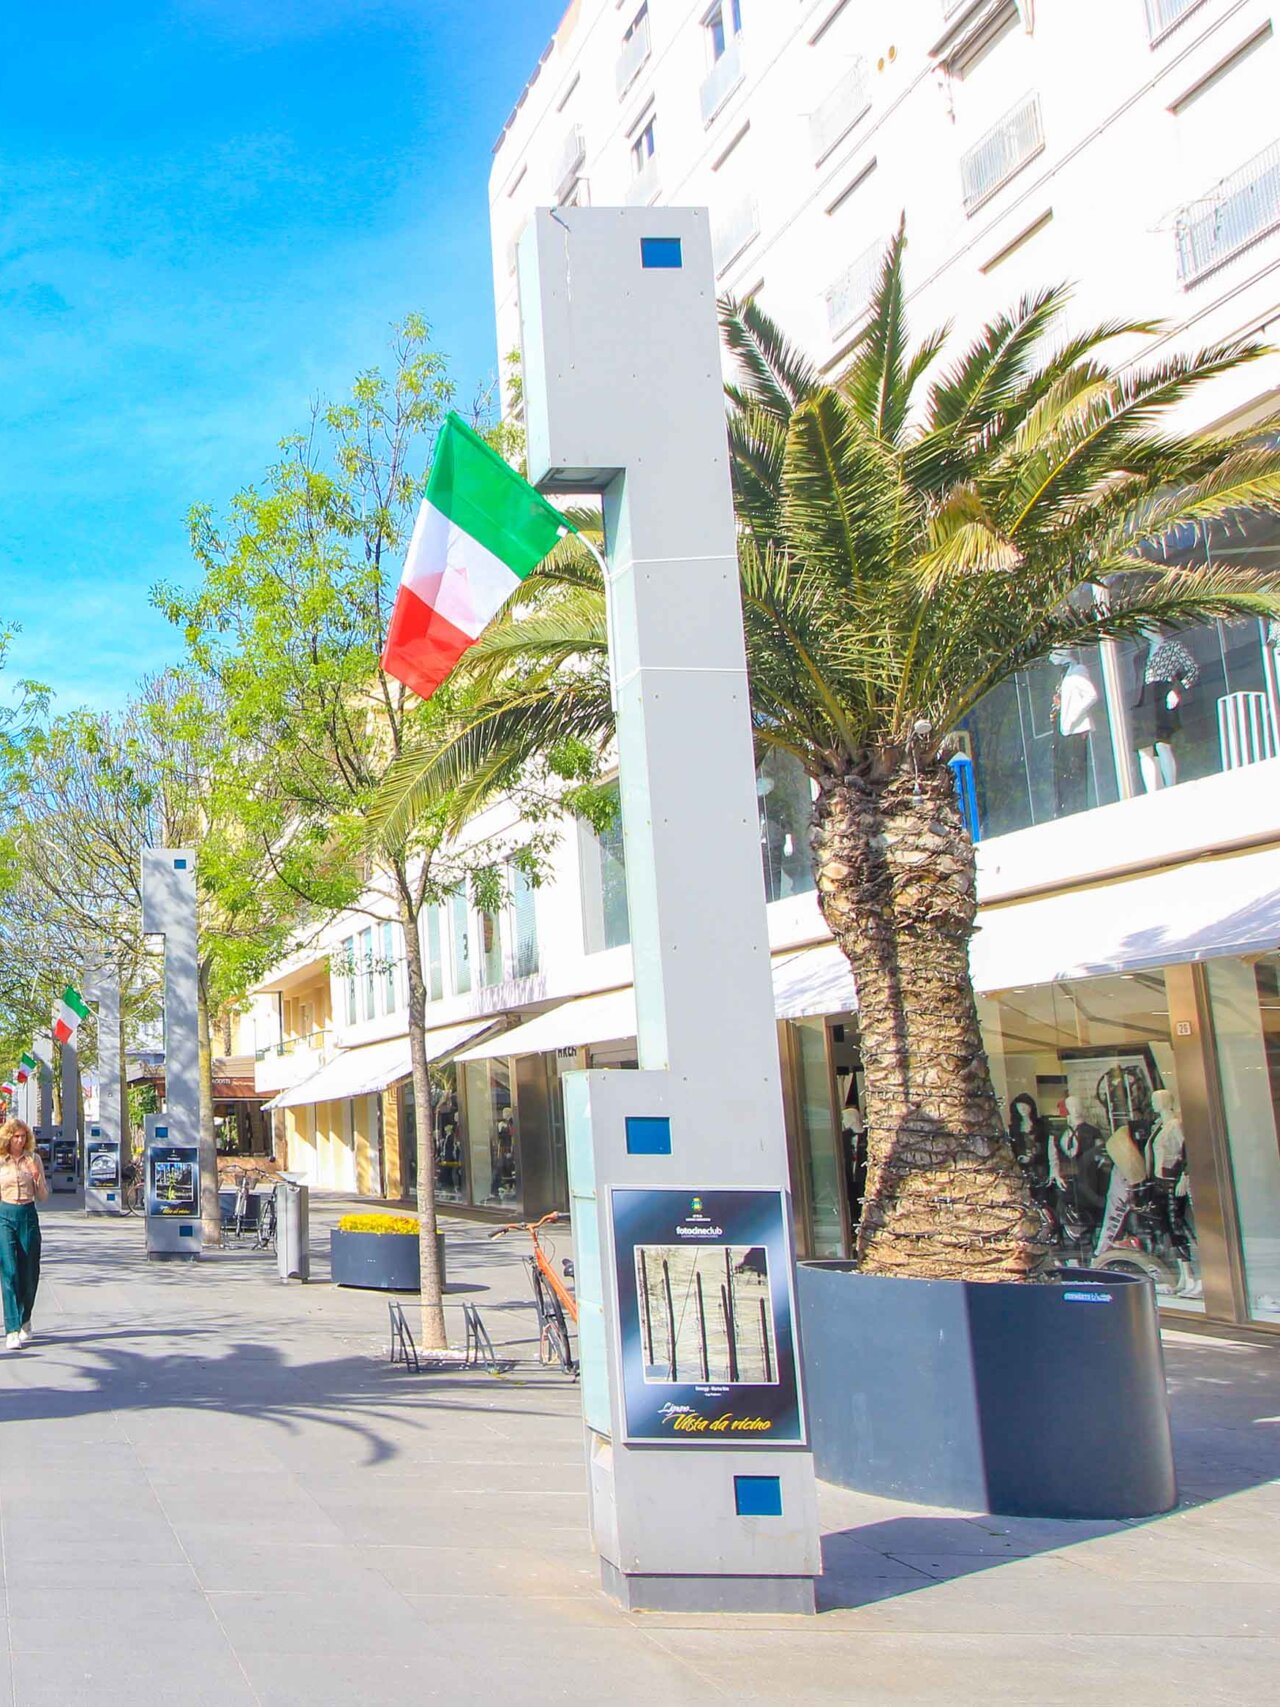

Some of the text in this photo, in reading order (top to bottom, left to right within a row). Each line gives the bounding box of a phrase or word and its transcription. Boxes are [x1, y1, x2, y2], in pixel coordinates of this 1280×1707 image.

[675, 1225, 723, 1236] fotocineclub
[662, 1412, 773, 1432] Vista da vicino
